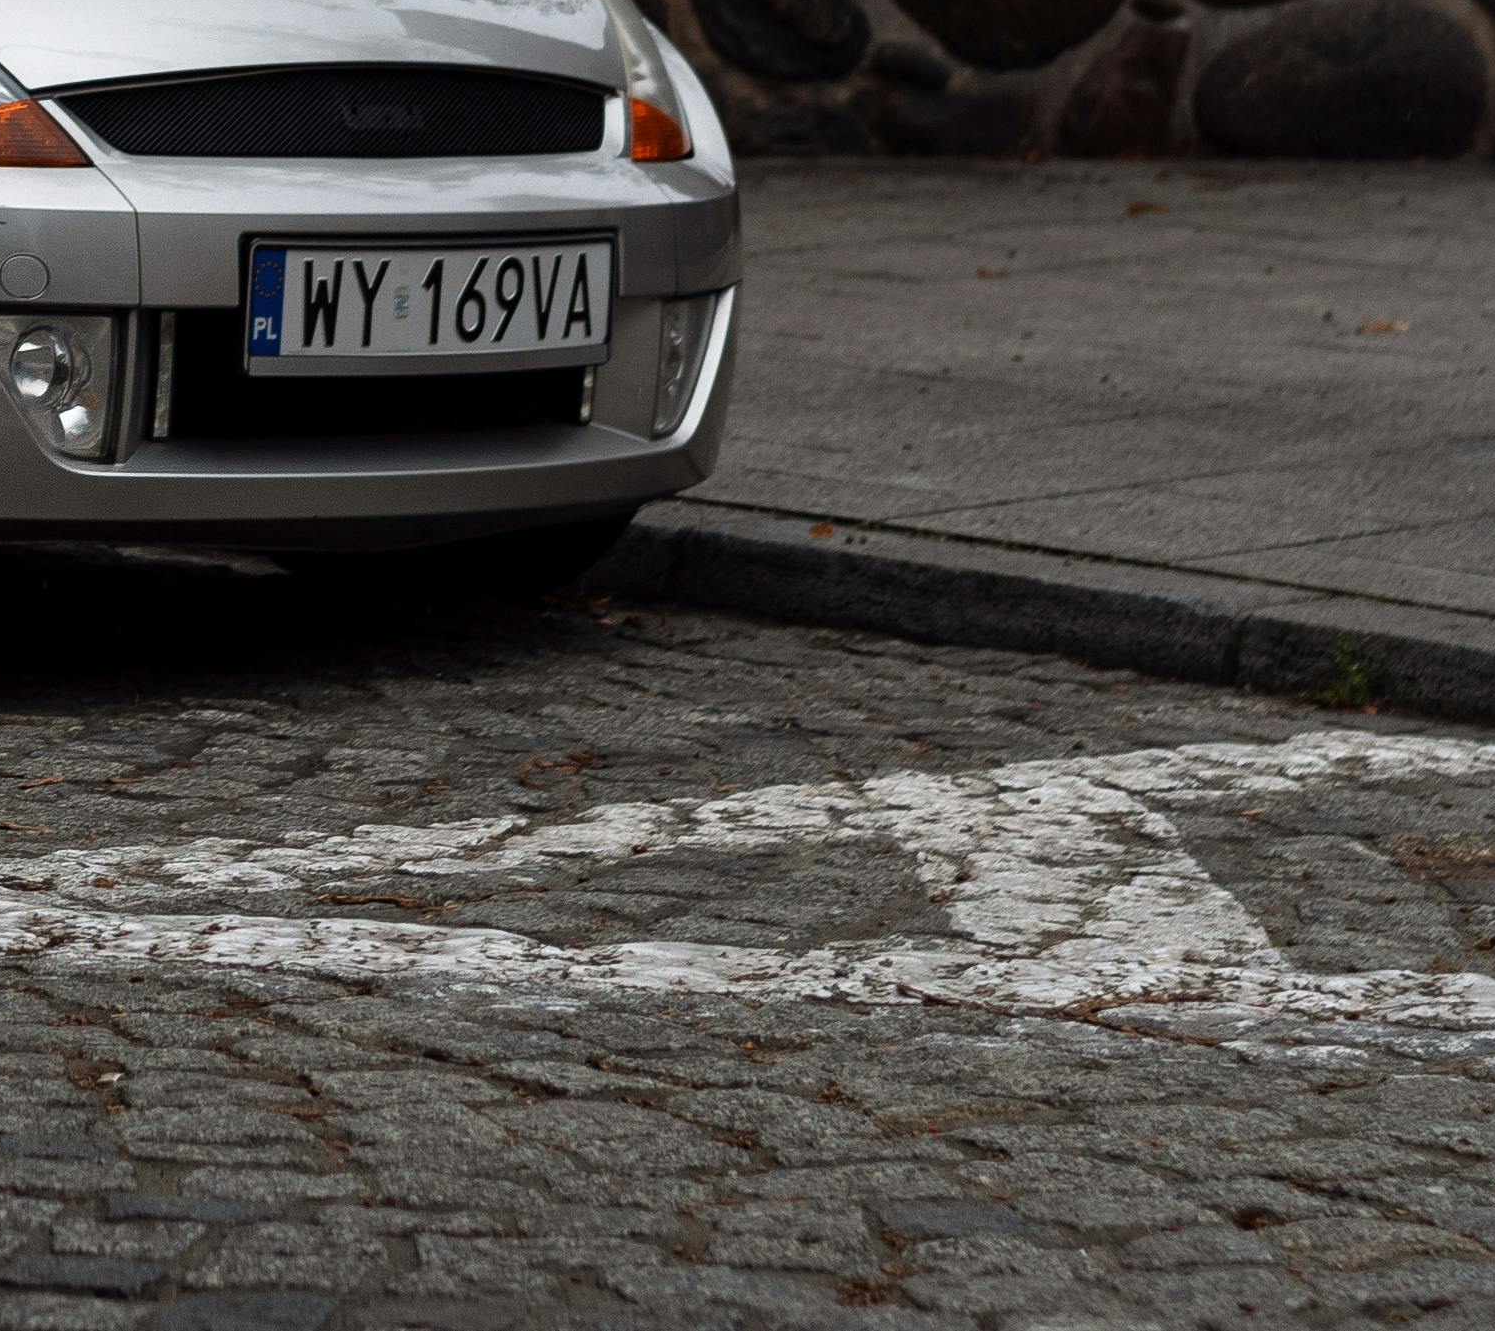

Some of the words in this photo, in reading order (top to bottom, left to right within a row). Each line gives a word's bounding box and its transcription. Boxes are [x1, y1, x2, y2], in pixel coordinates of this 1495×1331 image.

[252, 316, 277, 341] PL
[302, 258, 391, 348] WY
[420, 252, 592, 346] 169VA
